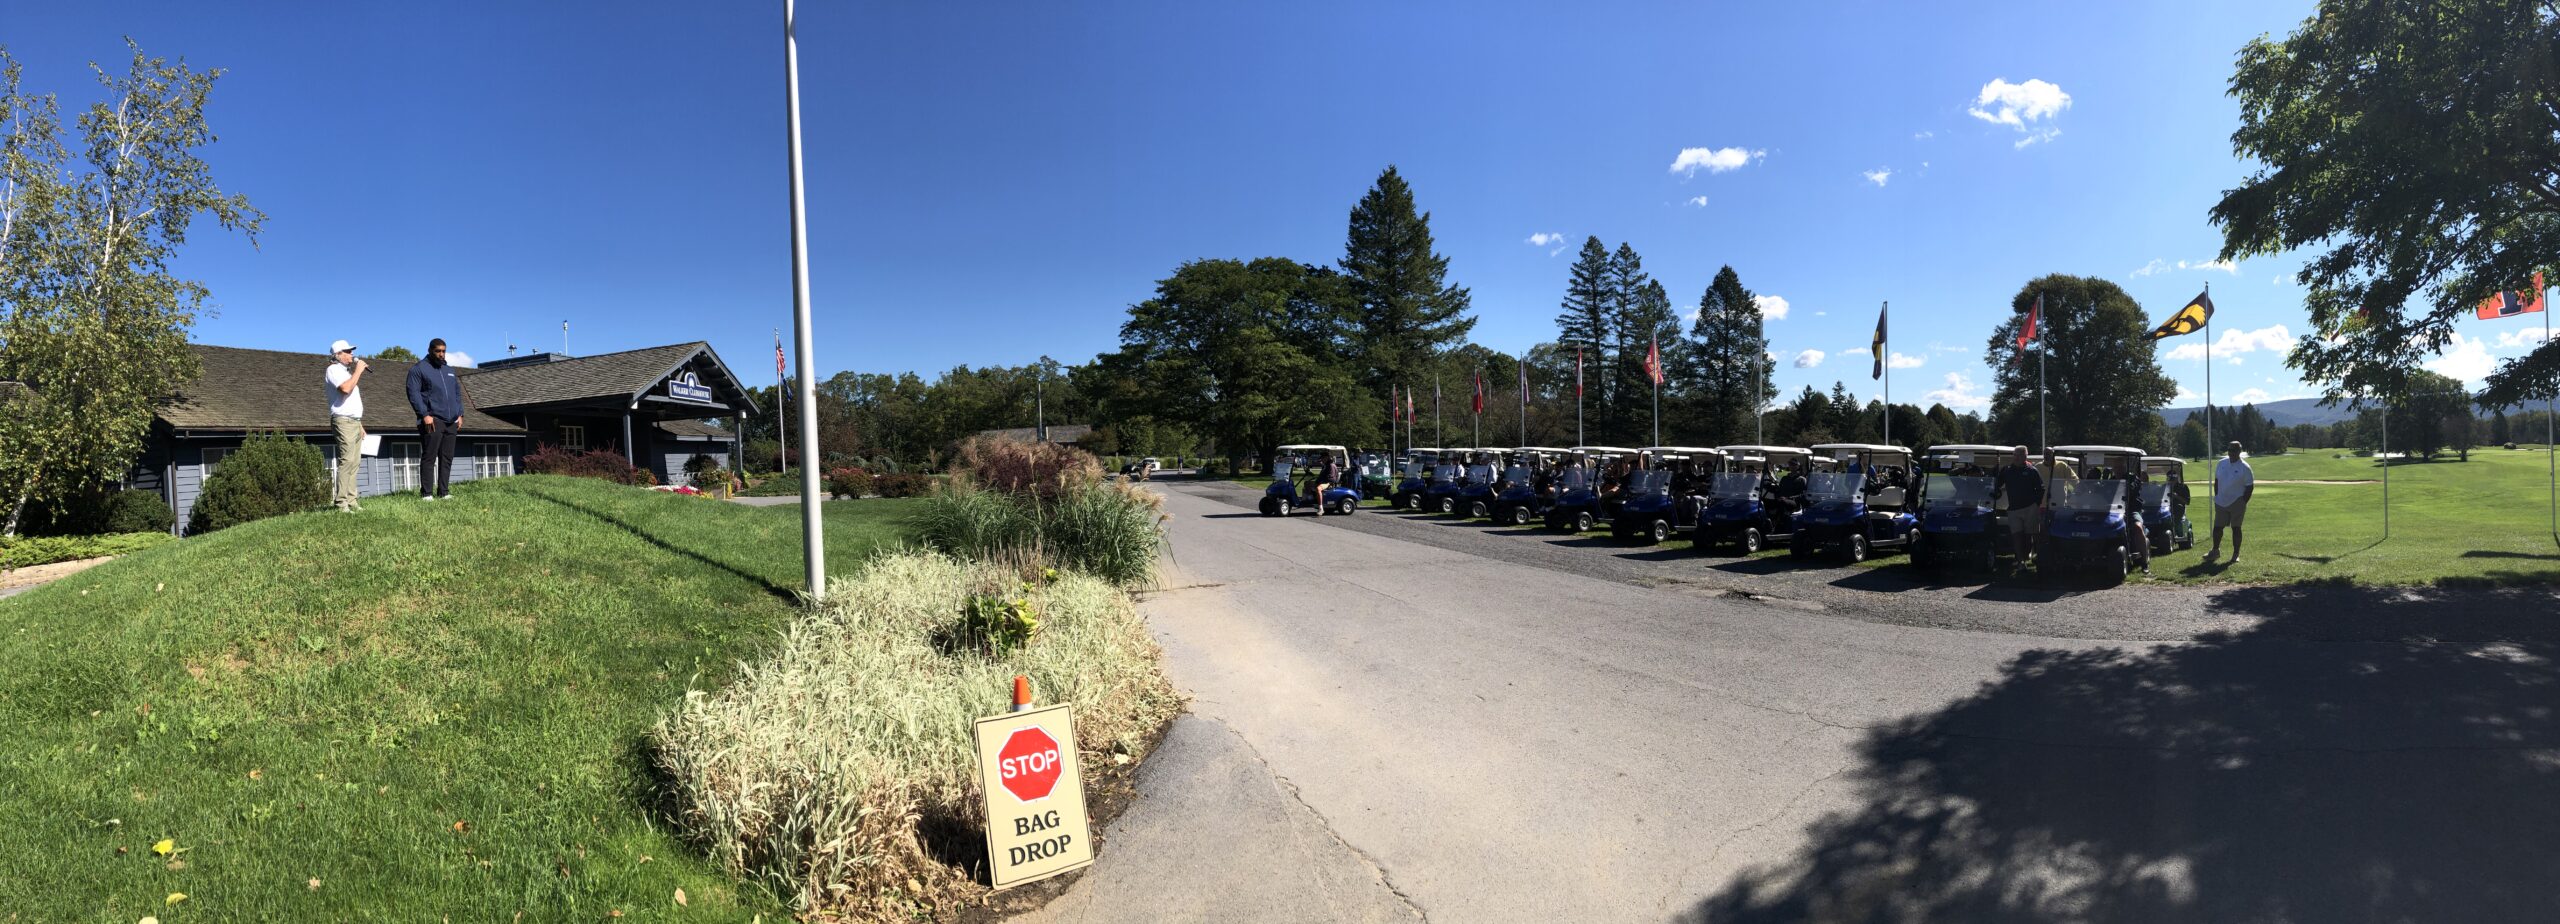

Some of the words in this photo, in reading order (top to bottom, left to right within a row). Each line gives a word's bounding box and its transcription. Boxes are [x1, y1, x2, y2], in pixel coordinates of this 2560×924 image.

[1002, 749, 1058, 779] STOP
[1014, 810, 1060, 836] BAG
[1009, 834, 1072, 867] DROP
